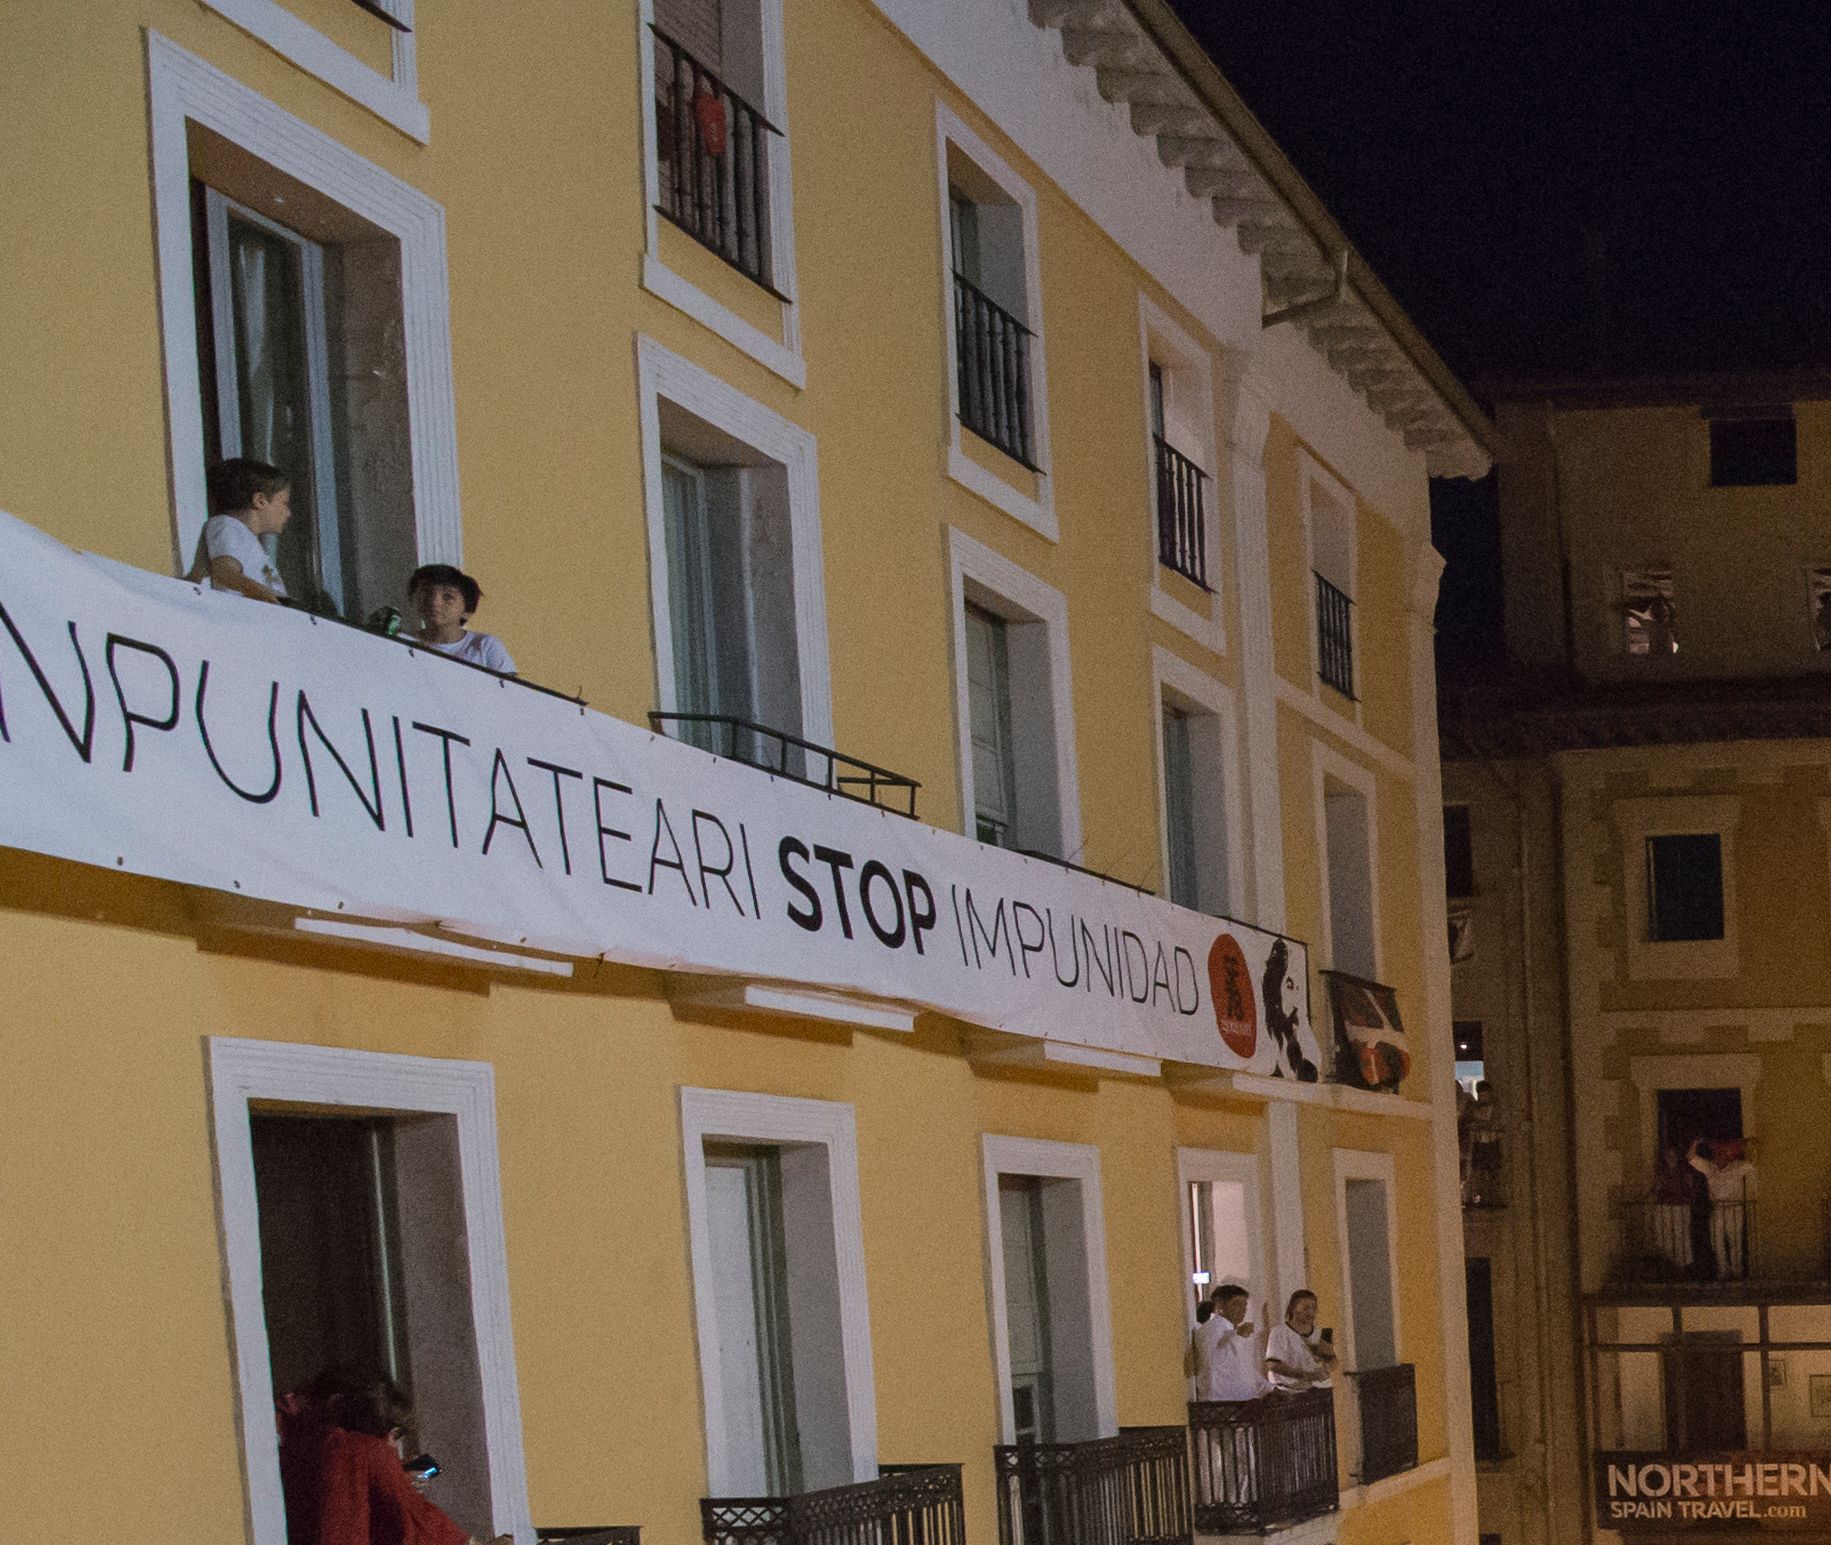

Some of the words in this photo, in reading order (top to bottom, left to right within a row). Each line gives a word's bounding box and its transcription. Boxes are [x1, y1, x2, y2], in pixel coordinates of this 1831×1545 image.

[778, 836, 936, 955] STOP
[952, 884, 1199, 1016] IMPUNIDAD
[1610, 1501, 1672, 1519] SPAIN
[1678, 1500, 1807, 1519] TRAVEL.com
